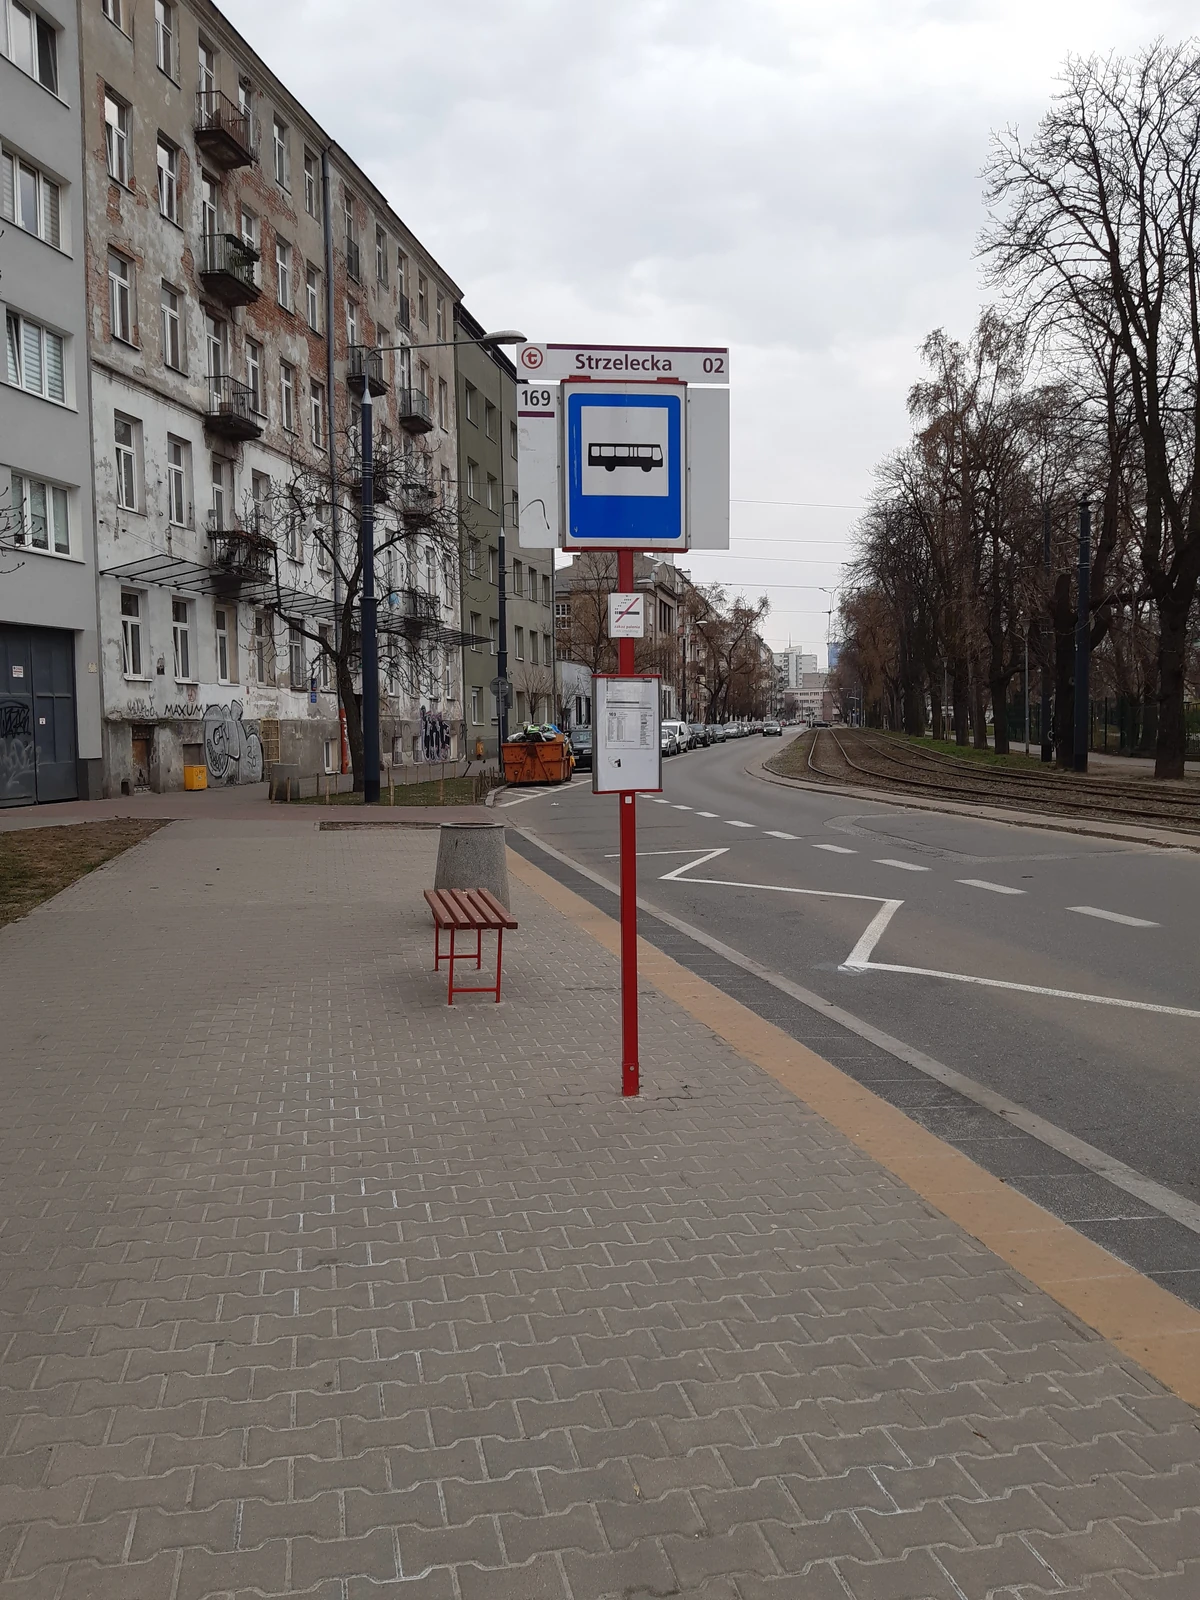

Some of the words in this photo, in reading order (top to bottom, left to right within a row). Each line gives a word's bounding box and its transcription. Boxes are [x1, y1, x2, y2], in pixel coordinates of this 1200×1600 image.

[575, 353, 673, 371] Strzelecka
[703, 357, 725, 374] 02
[521, 389, 551, 407] 169
